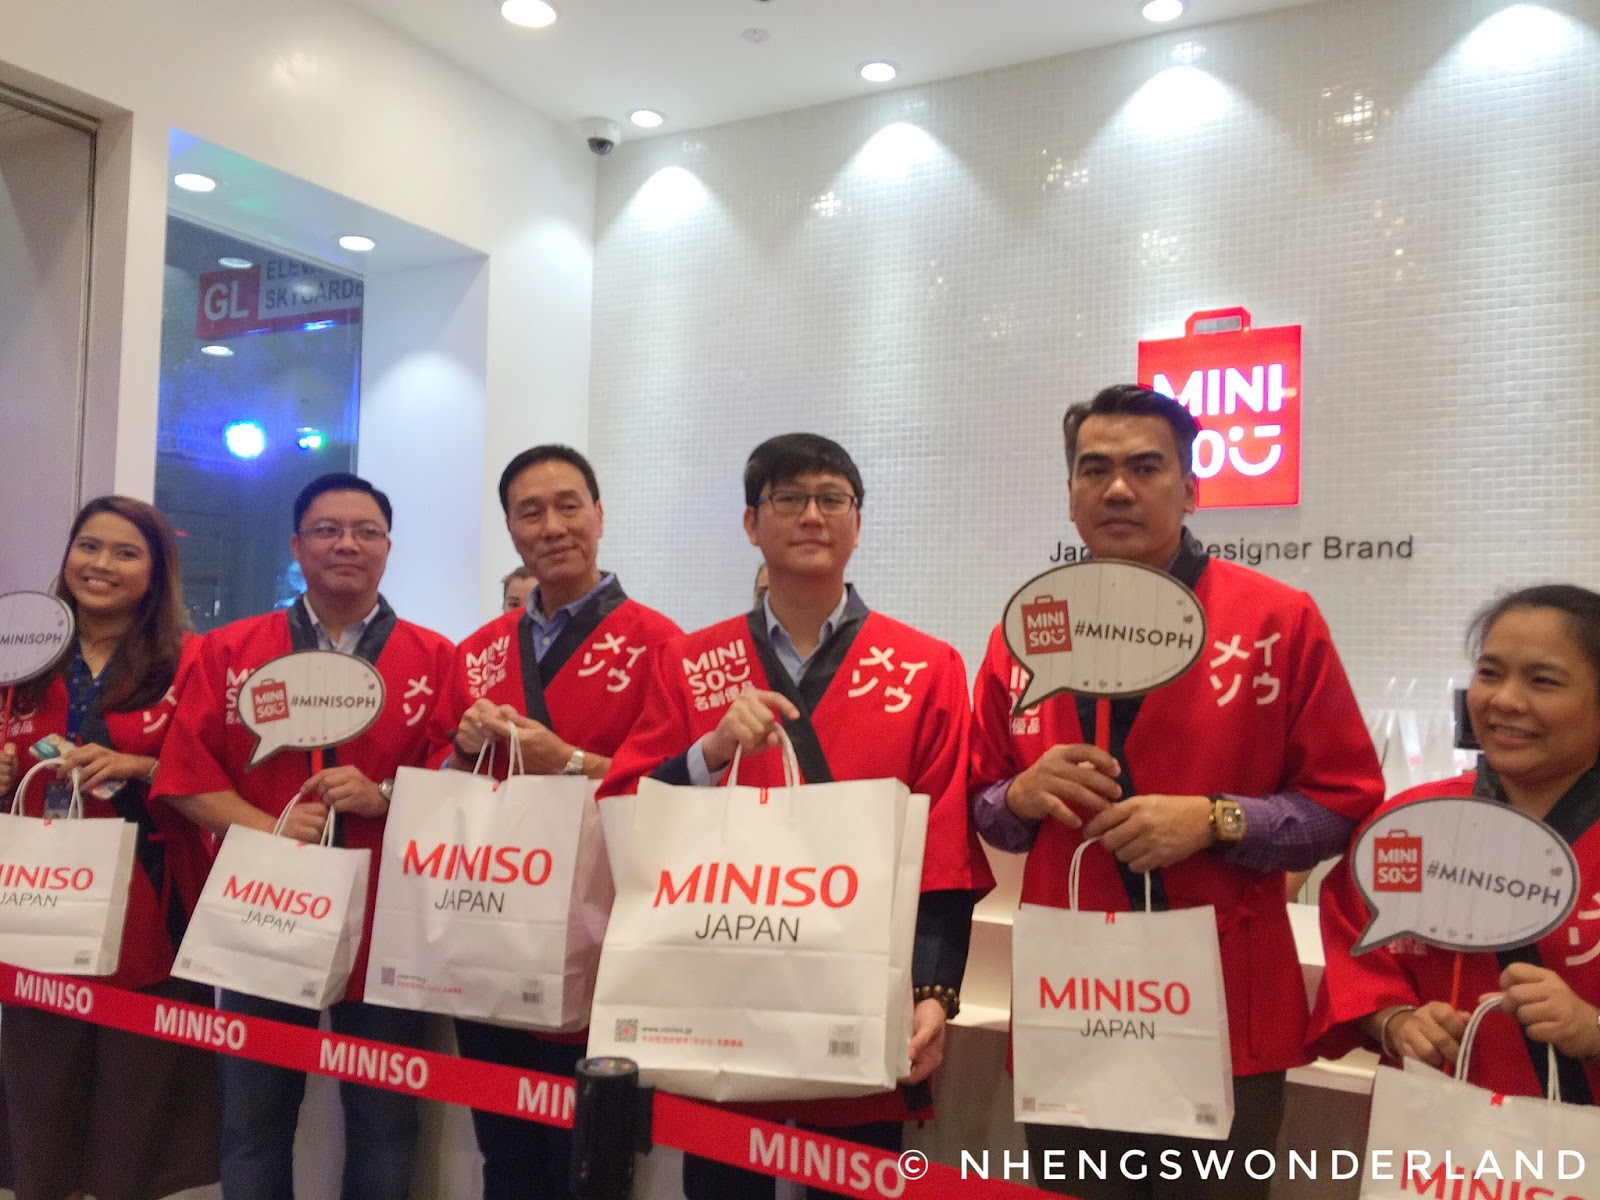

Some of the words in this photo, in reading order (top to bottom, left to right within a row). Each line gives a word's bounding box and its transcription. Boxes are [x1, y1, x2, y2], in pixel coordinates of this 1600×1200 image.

[203, 280, 250, 322] GL
[1152, 363, 1284, 417] MINI
[1196, 538, 1312, 565] esigner
[1324, 536, 1414, 559] Brand
[1026, 611, 1066, 630] MINI
[0, 632, 62, 645] MINISOPH
[1074, 620, 1195, 651] #MINISOPH
[682, 639, 746, 676] MINI
[254, 688, 285, 705] MINI
[291, 695, 376, 709] #MINISOPH
[402, 839, 553, 886] MINISO
[1377, 848, 1418, 864] MINI
[0, 864, 94, 891] INISO
[653, 861, 859, 909] MINISO
[1427, 859, 1561, 908] #MINISOPH
[0, 892, 58, 907] JAPAN
[222, 874, 332, 920] MINISO
[434, 888, 506, 914] JAPAN
[241, 910, 298, 934] JAPAN
[695, 913, 800, 943] JAPAN
[1039, 975, 1191, 1016] MINISO
[1079, 1018, 1156, 1040] JAPAN
[14, 970, 94, 1015] MINISO
[154, 1003, 247, 1051] MINISO
[319, 1037, 429, 1090] MINISO
[517, 1076, 576, 1120] MIN
[749, 1127, 907, 1199] MINISO
